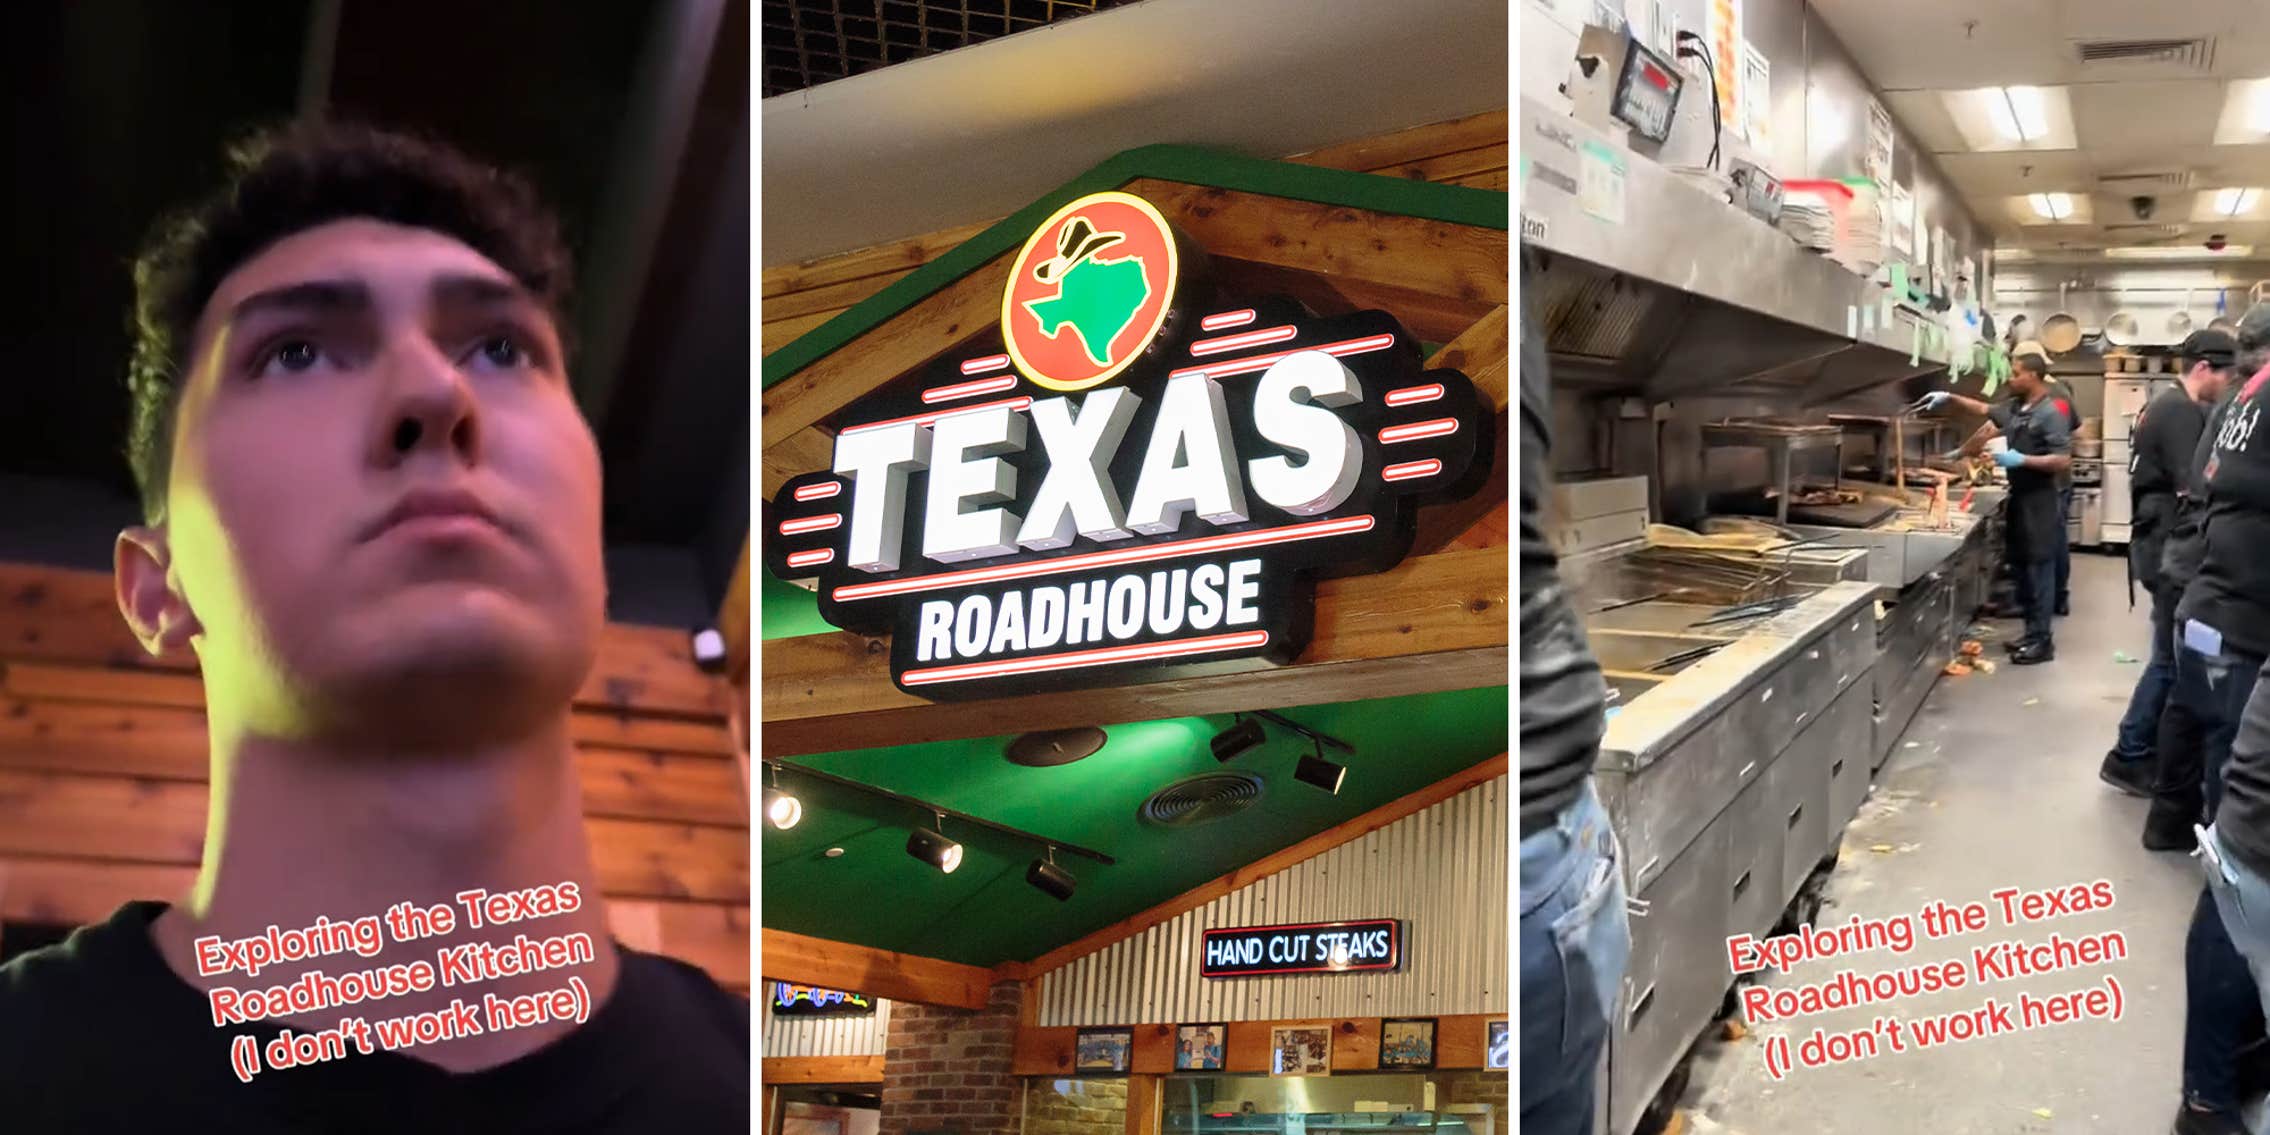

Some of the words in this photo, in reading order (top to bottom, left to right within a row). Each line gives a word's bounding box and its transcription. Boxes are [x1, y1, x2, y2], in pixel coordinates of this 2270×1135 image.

[833, 349, 1363, 572] TEXAS
[916, 558, 1263, 662] ROADHOUSE
[1207, 937, 1263, 966] HAND
[1269, 935, 1310, 963] CUT
[1315, 930, 1388, 961] STEAKS
